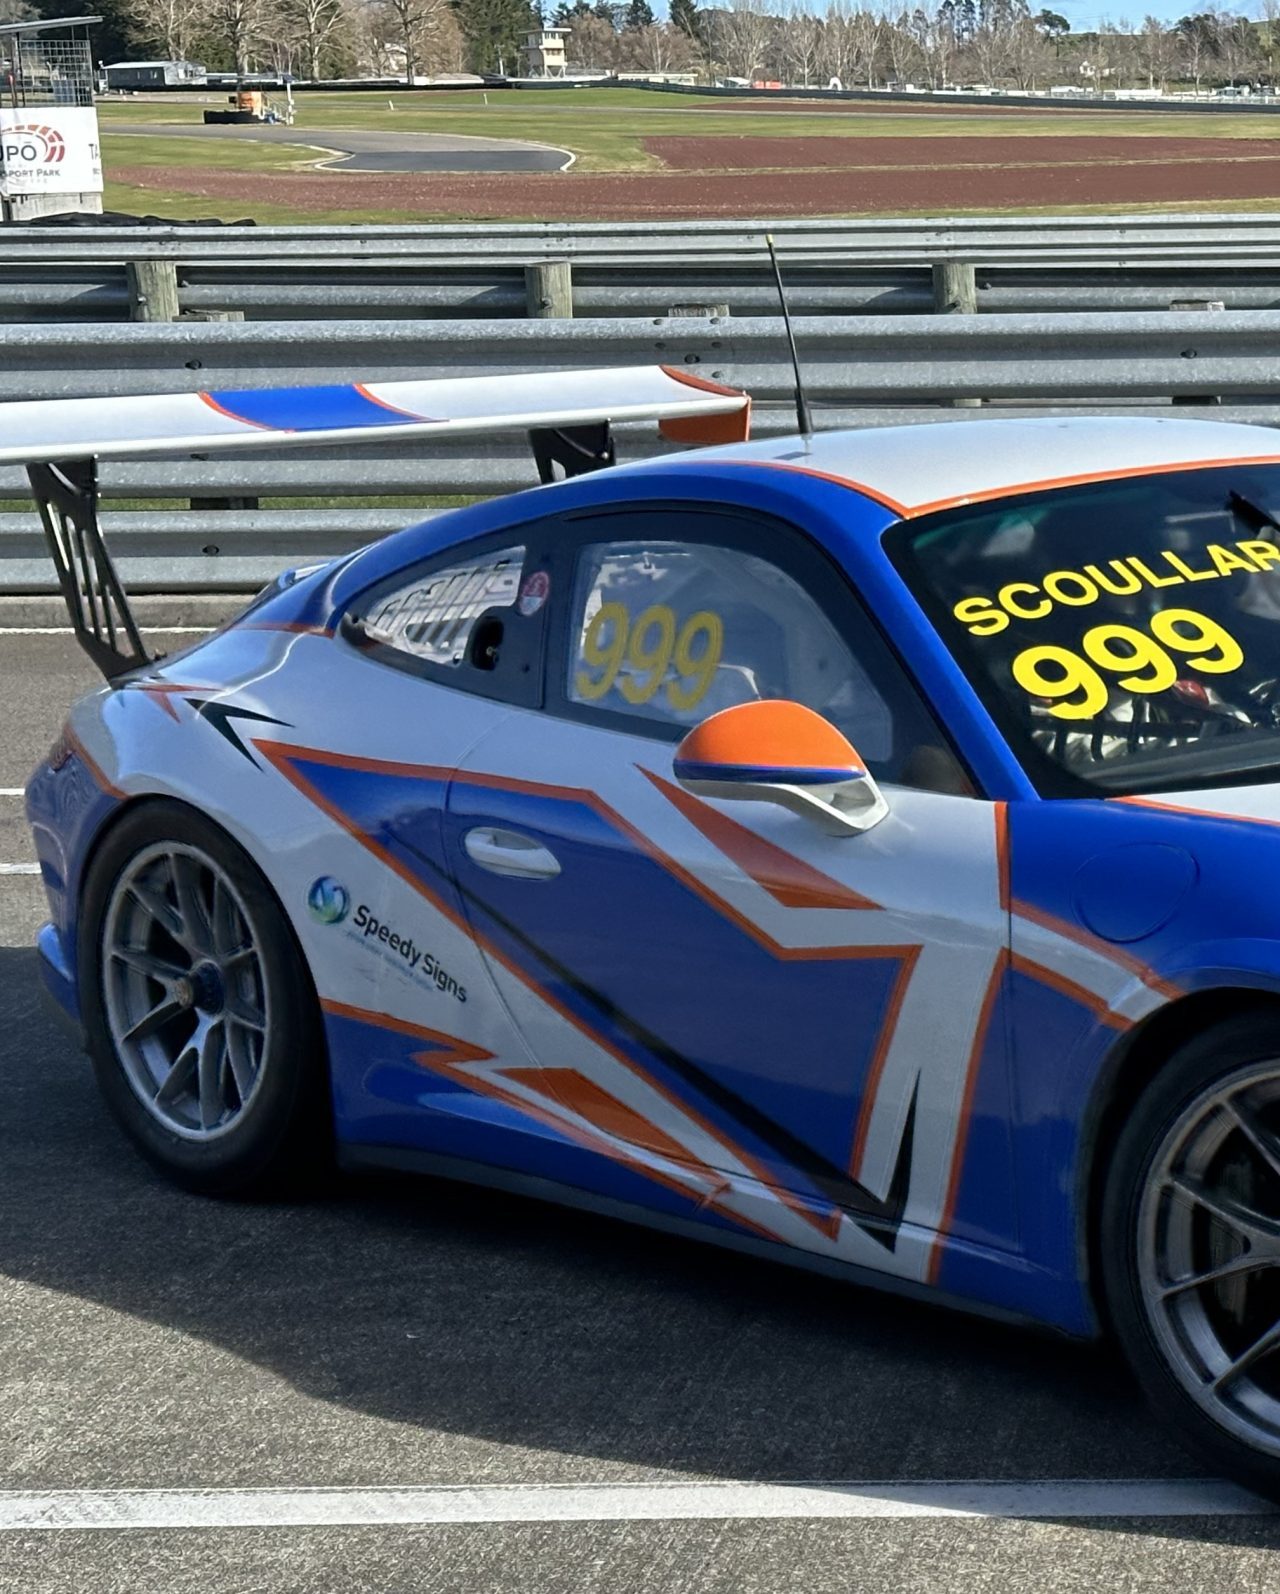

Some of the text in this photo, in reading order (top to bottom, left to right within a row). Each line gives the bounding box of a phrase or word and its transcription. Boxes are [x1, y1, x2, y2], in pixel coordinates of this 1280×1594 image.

[576, 601, 723, 711] 999
[1012, 608, 1245, 720] 999
[353, 904, 422, 967] Speedy
[422, 953, 468, 1003] Signs
